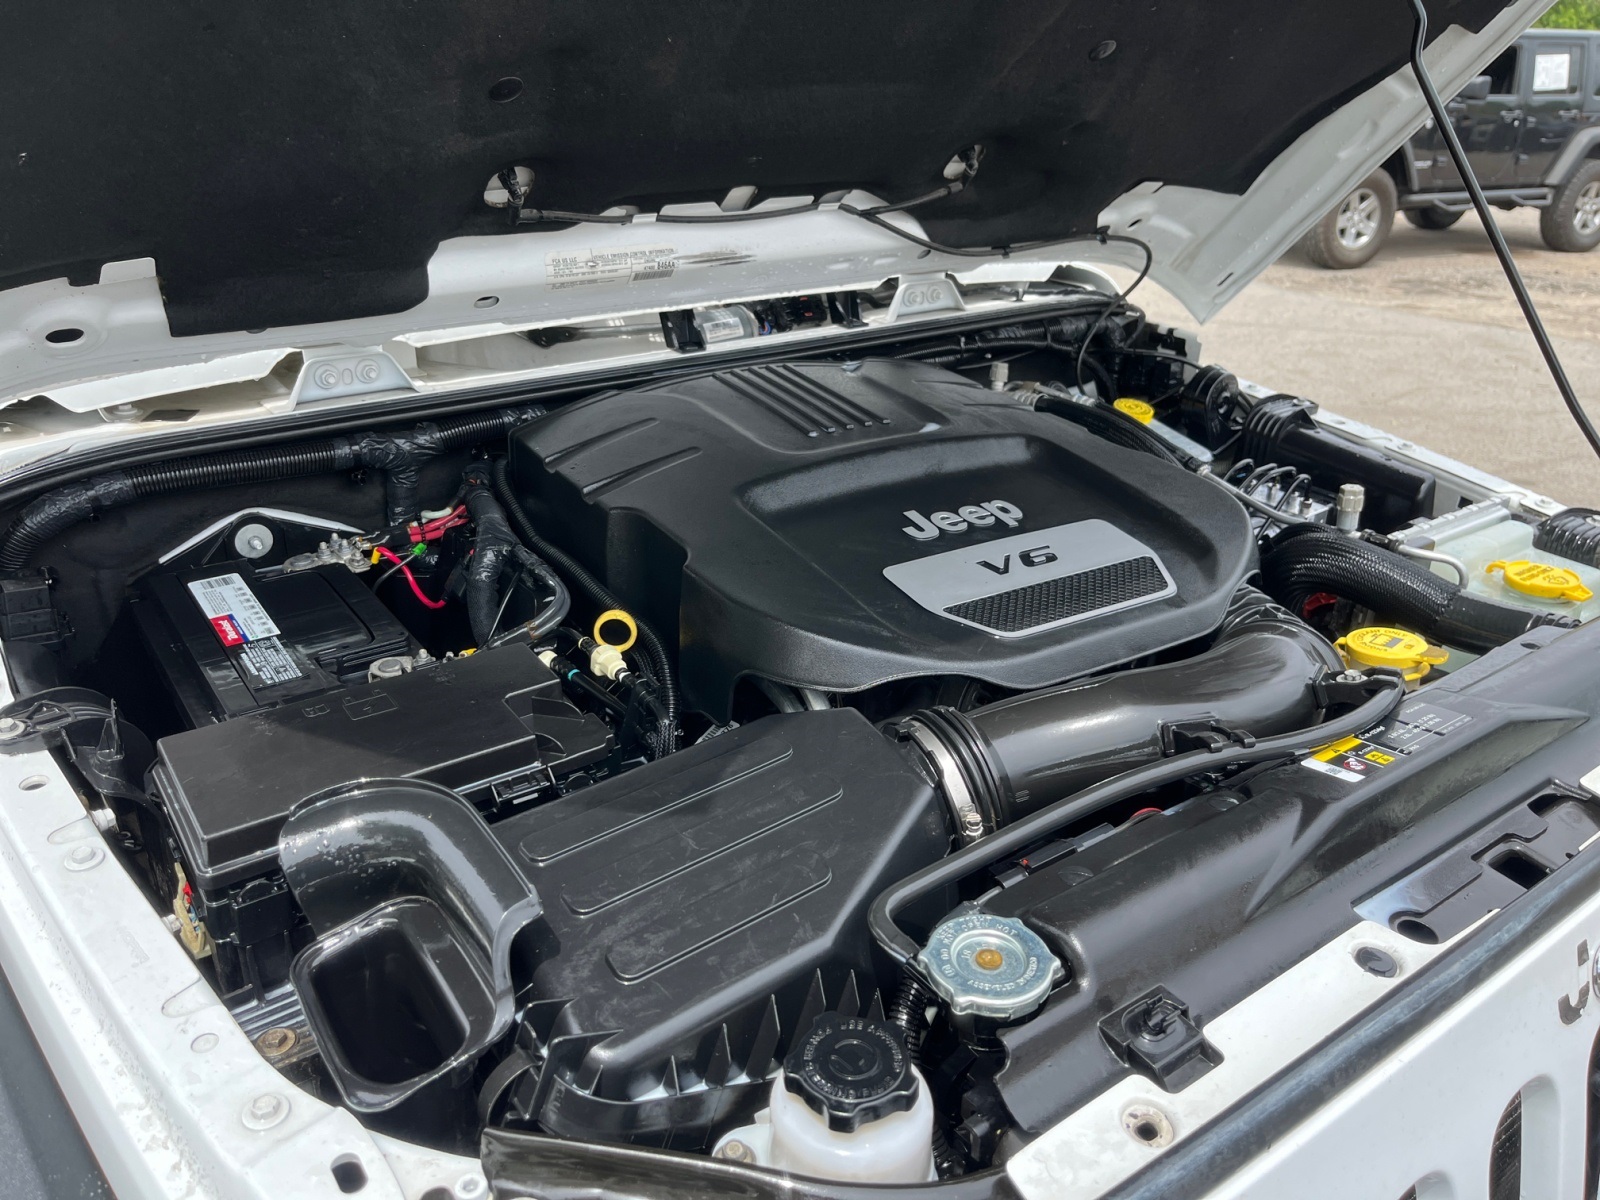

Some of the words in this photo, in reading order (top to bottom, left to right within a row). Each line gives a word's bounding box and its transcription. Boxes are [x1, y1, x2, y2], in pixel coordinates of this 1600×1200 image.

[901, 498, 1024, 541] Jeep
[975, 545, 1059, 576] V6
[943, 931, 958, 946] NOT
[996, 923, 1018, 936] HOT
